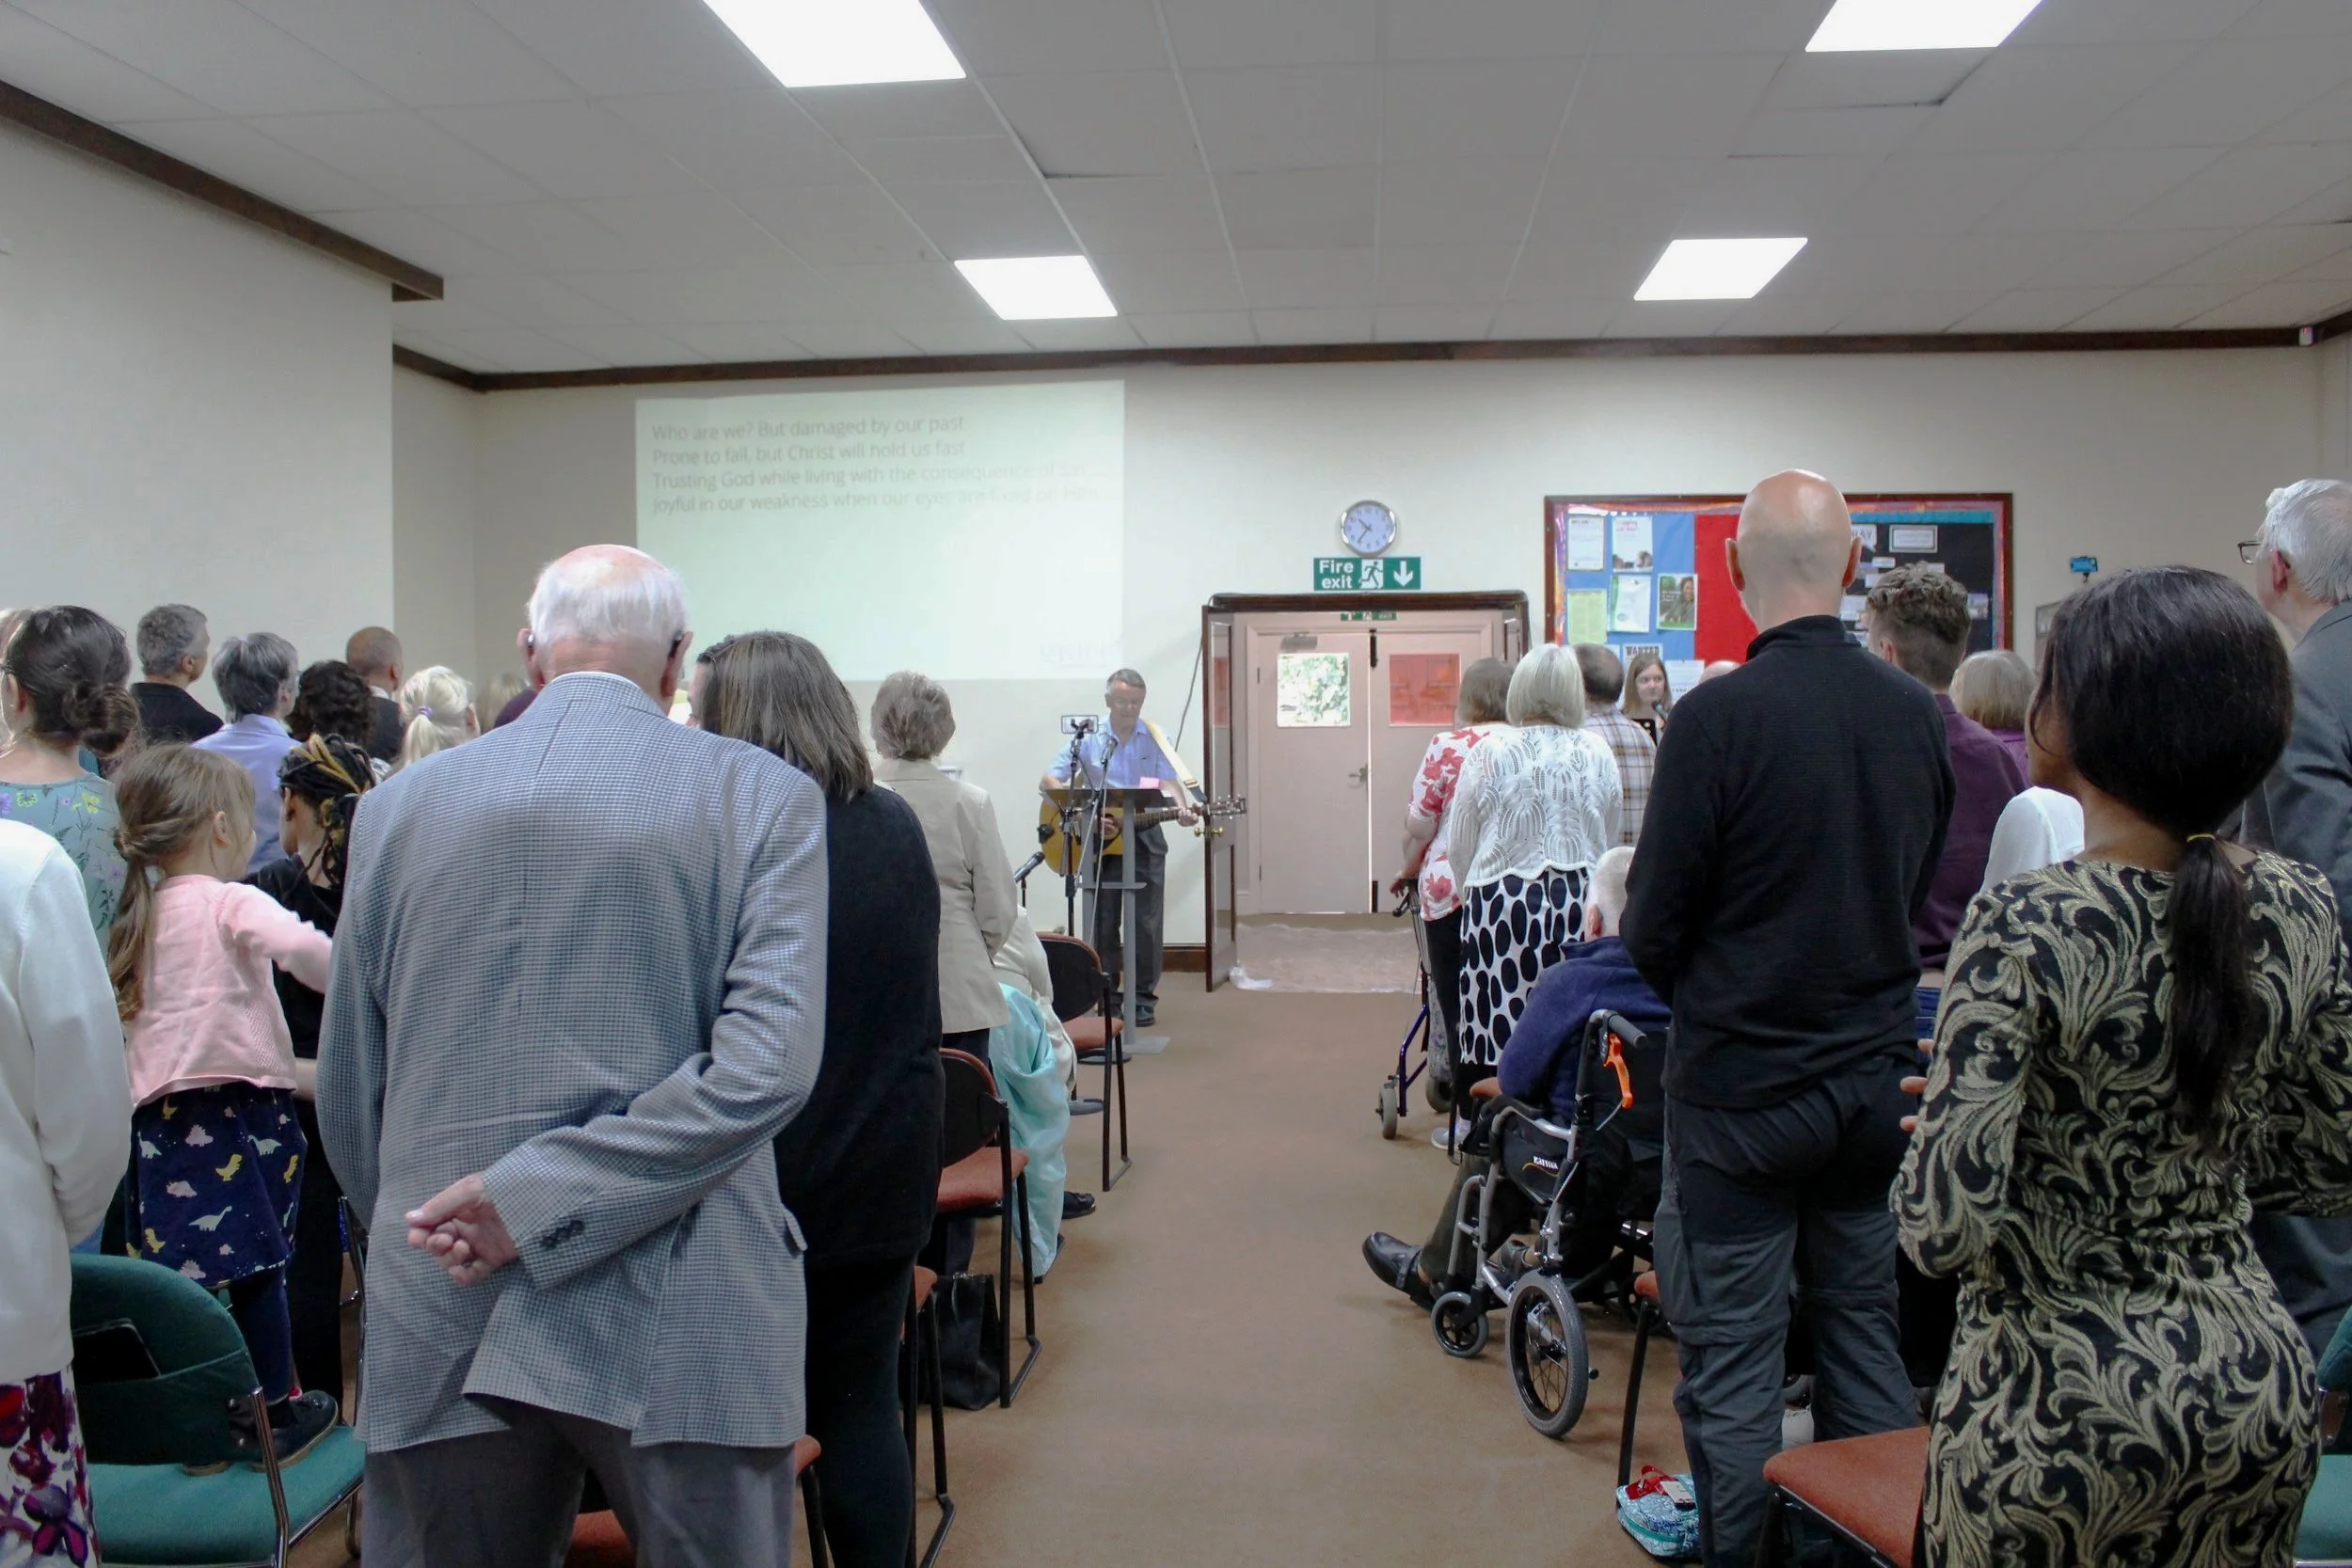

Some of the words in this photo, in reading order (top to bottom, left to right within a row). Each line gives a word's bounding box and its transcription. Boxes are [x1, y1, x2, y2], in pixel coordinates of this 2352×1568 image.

[651, 424, 689, 440] Who
[692, 426, 719, 441] are
[723, 421, 754, 439] we?
[757, 420, 786, 437] But
[790, 419, 866, 438] damaged
[870, 417, 891, 437] by
[895, 418, 924, 433] our
[929, 416, 966, 435] past
[652, 449, 704, 466] Prone
[705, 449, 722, 464] to
[756, 447, 784, 462] but
[787, 444, 835, 461] Christ
[839, 443, 866, 459] will
[870, 442, 907, 458] hold
[912, 443, 931, 458] us
[935, 440, 966, 458] fast
[652, 472, 718, 492] Trusting
[721, 470, 755, 488] God
[758, 468, 801, 485] while
[805, 467, 846, 487] living
[850, 467, 884, 483] with
[889, 465, 916, 482] the
[699, 496, 715, 512] in
[718, 497, 746, 511] our
[749, 493, 828, 510] weakness
[833, 490, 876, 508] when
[882, 490, 909, 506] our
[1319, 560, 1355, 574] Fire
[1321, 575, 1353, 589] exit
